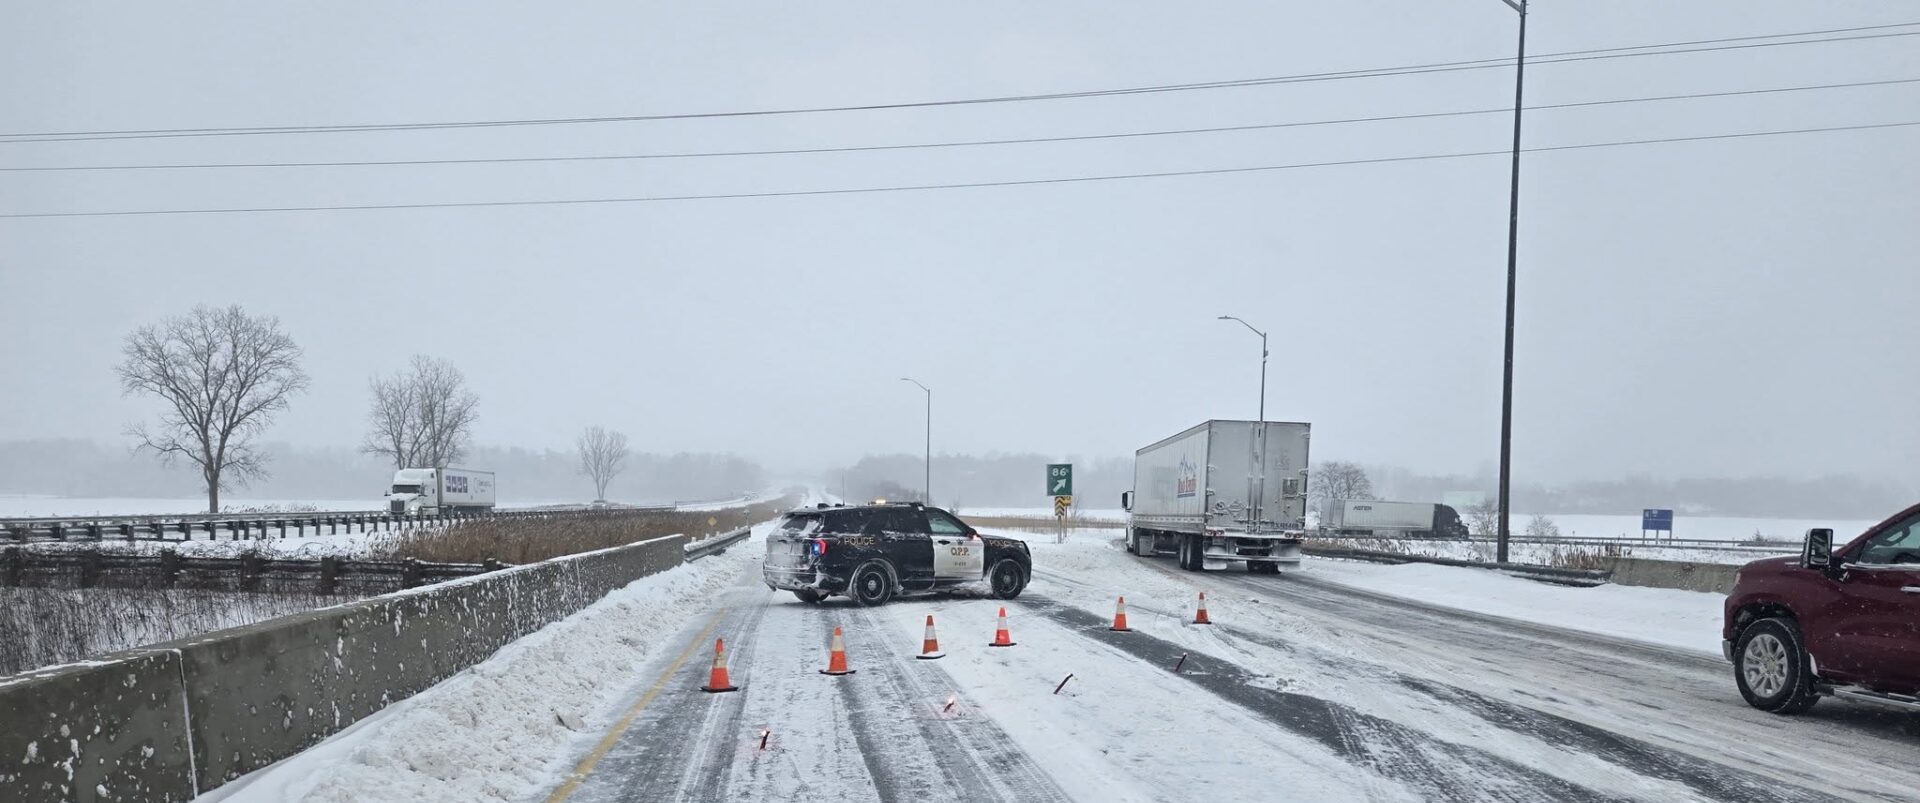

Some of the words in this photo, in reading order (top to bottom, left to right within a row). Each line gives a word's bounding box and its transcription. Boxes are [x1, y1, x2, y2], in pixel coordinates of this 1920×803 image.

[1052, 467, 1066, 476] 86
[844, 537, 875, 545] POLICE
[950, 547, 970, 556] O.P.P.
